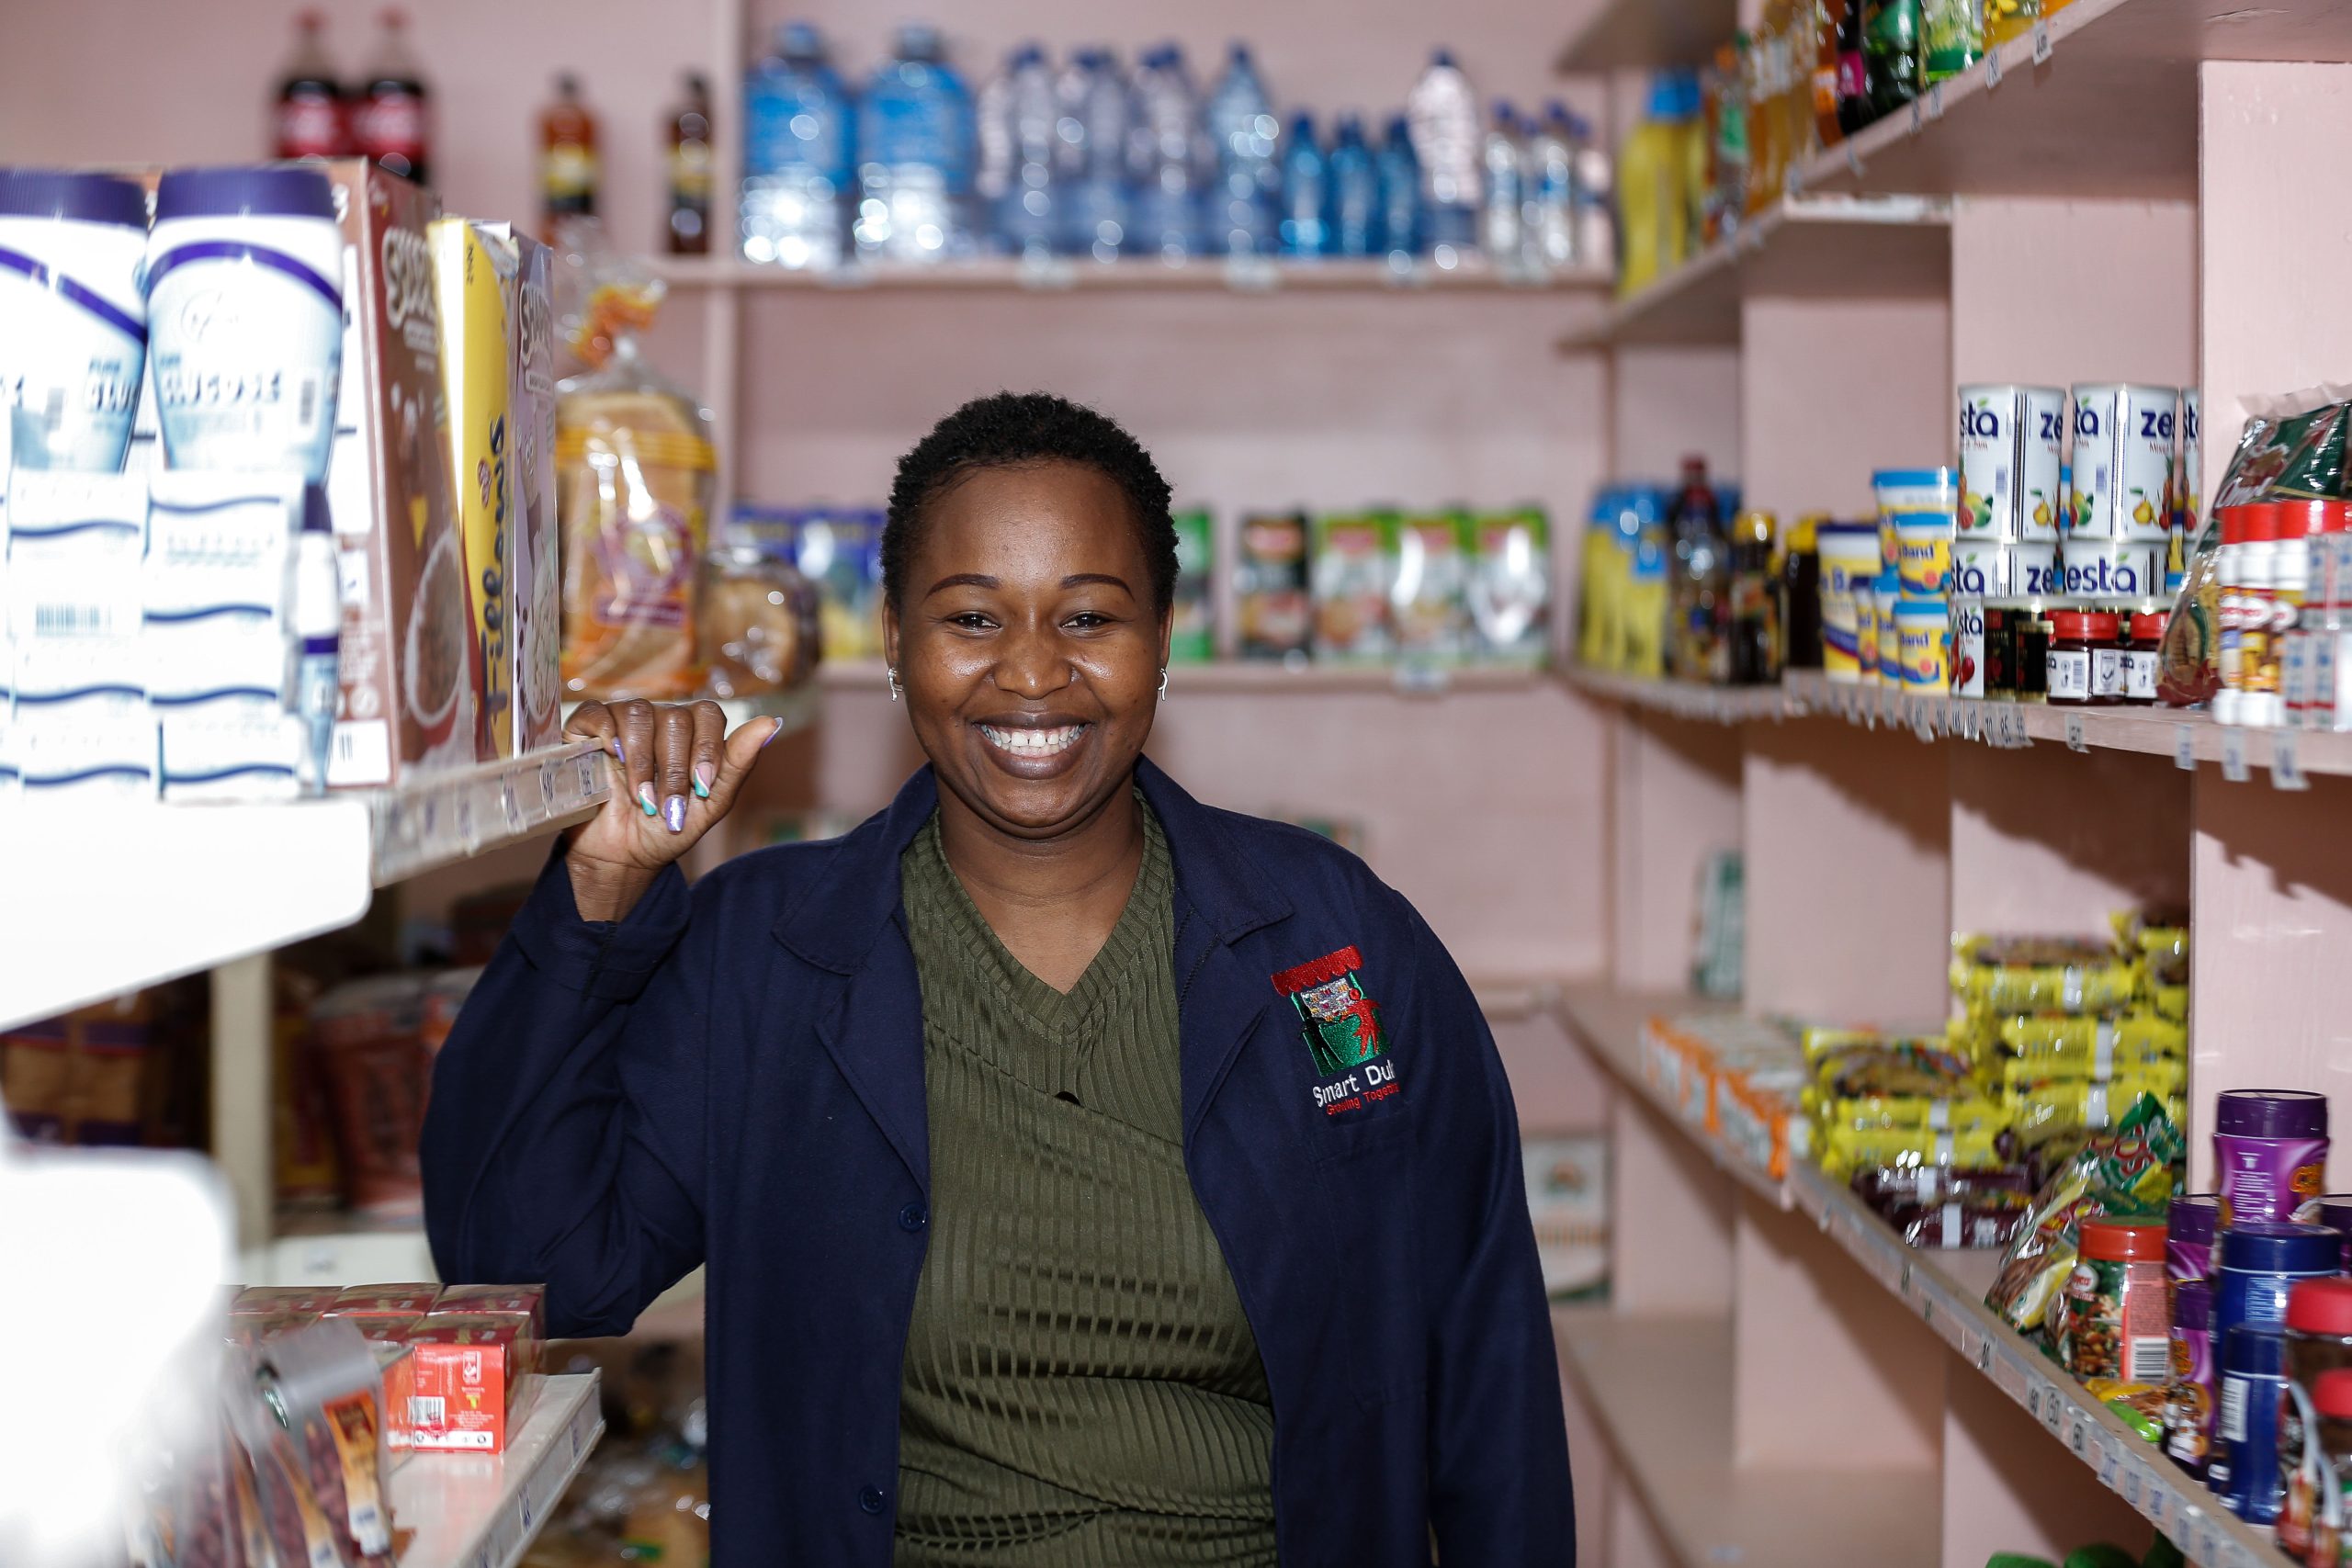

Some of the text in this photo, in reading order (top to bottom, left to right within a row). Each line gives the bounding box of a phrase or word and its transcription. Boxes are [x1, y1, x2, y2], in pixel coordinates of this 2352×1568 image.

[2073, 398, 2099, 438] ta
[2140, 408, 2176, 440] ze
[2062, 555, 2137, 593] esta
[1312, 1073, 1361, 1108] Smart
